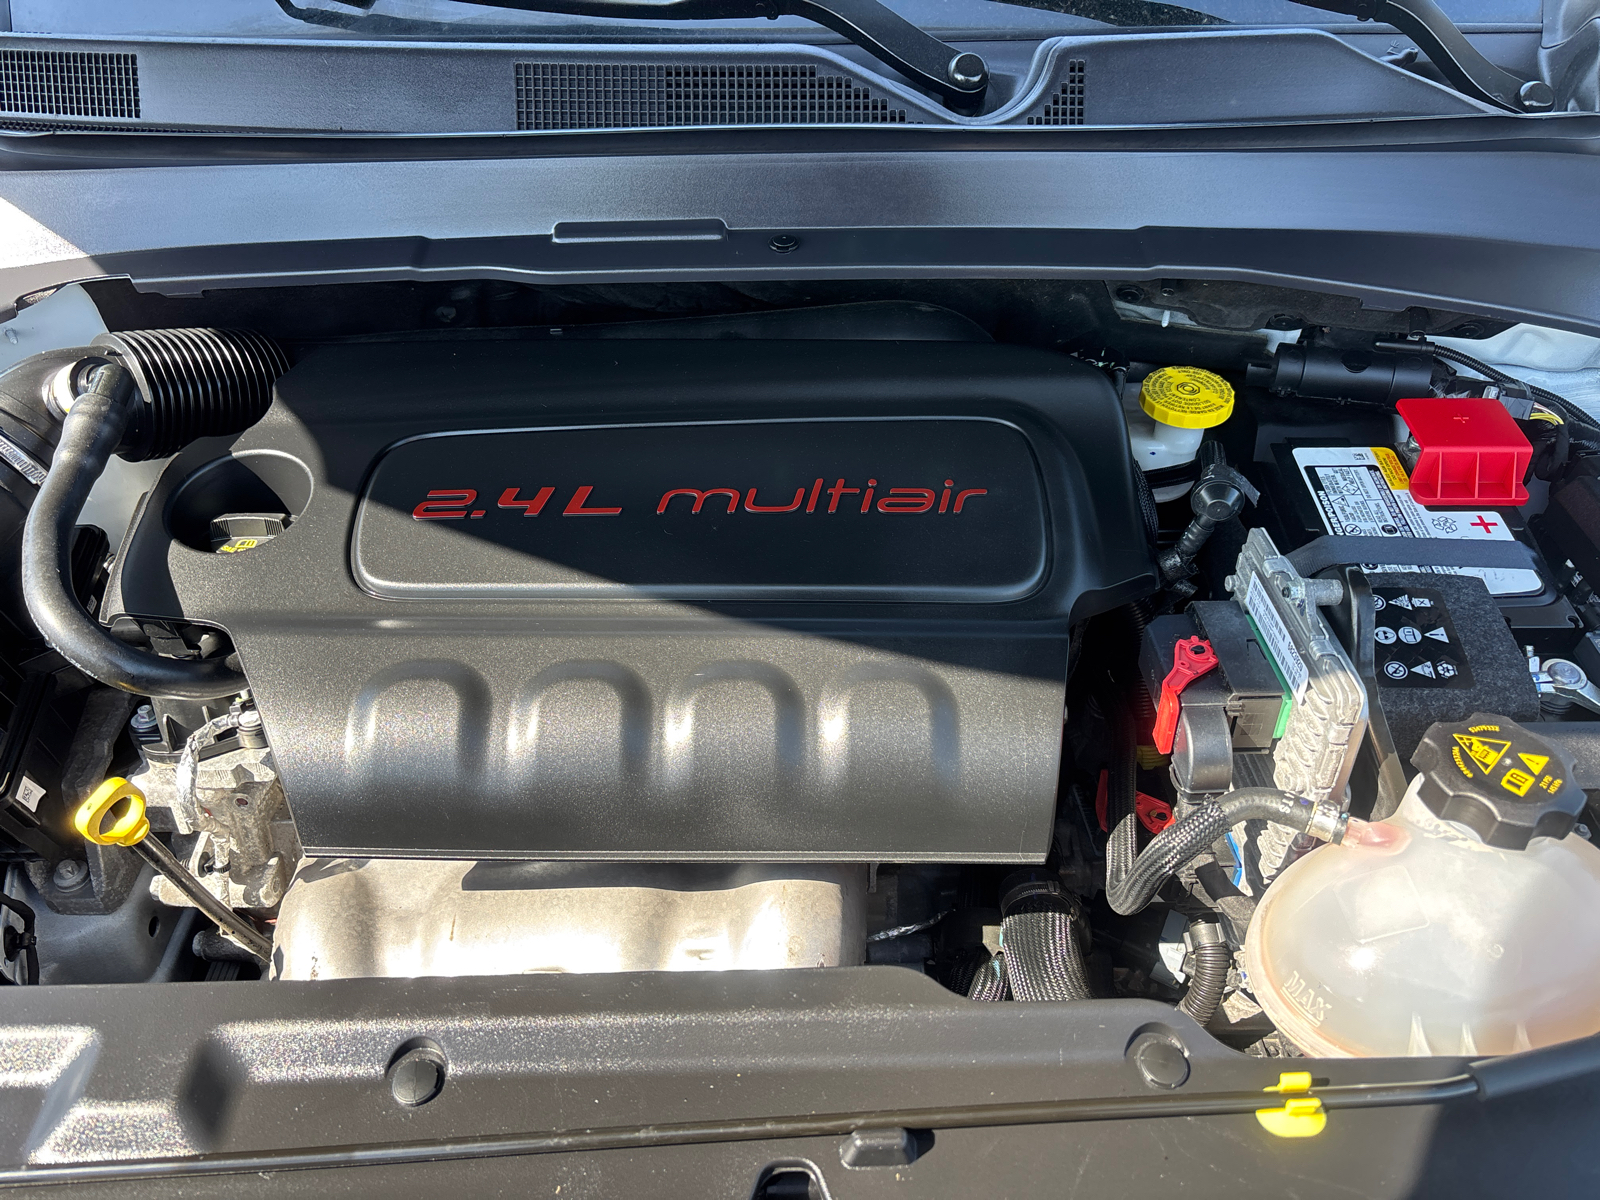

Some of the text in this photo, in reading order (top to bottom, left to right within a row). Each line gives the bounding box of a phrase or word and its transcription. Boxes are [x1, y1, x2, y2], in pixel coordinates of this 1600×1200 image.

[412, 478, 988, 520] 2.4L multiair
[1283, 970, 1333, 1022] MAX
